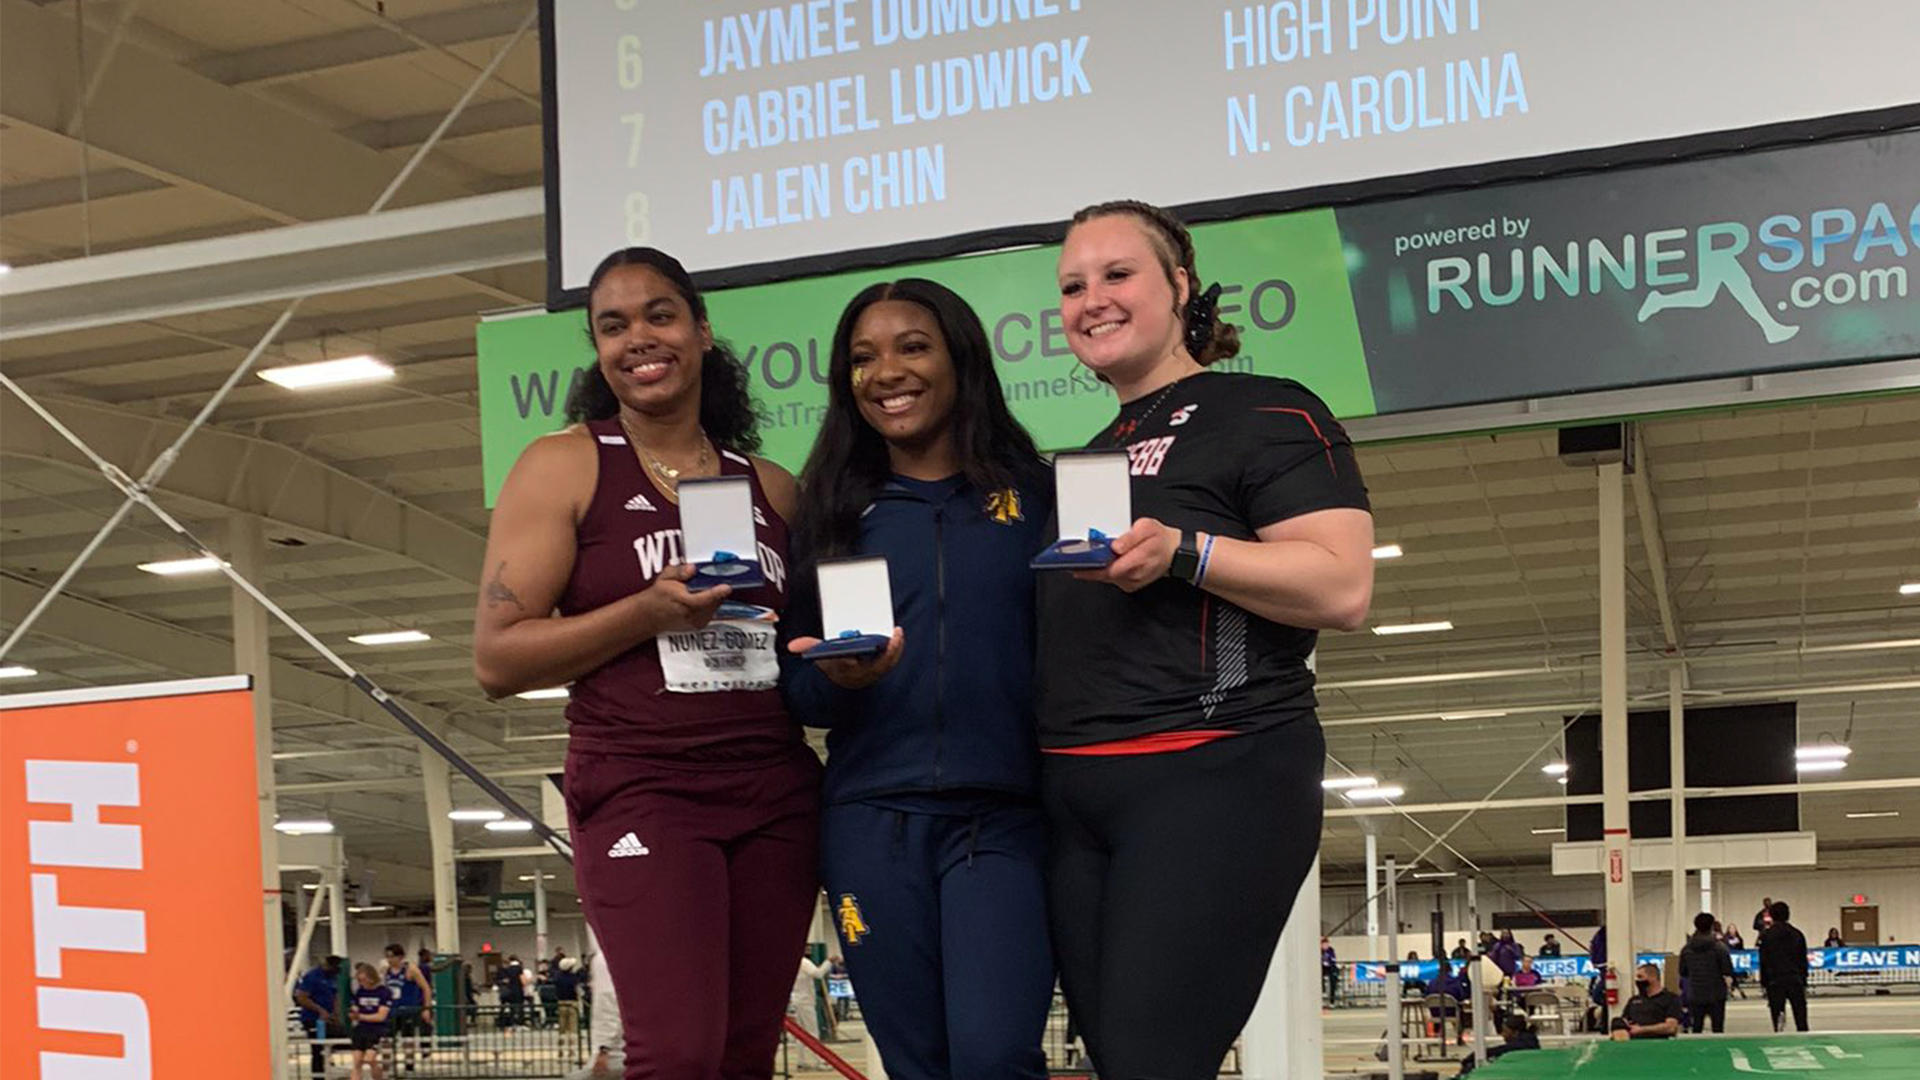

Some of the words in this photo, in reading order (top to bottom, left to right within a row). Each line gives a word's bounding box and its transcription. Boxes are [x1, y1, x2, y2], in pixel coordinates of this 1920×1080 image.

[617, 34, 643, 90] 6
[700, 0, 860, 77] JAYMEE
[1224, 0, 1332, 70] HIGH
[620, 112, 645, 169] 7
[702, 75, 880, 156] GABRIEL
[890, 36, 1092, 125] LUDWICK
[1226, 94, 1271, 156] N.
[1285, 52, 1529, 147] CAROLINA
[625, 190, 650, 246] 8
[707, 162, 830, 235] JALEN
[842, 144, 946, 213] CHIN
[1395, 218, 1496, 257] powered
[1502, 216, 1531, 239] by
[1427, 202, 1920, 343] RUNNERSPA
[1777, 266, 1908, 311] .com
[1836, 951, 1899, 967] LEAVE
